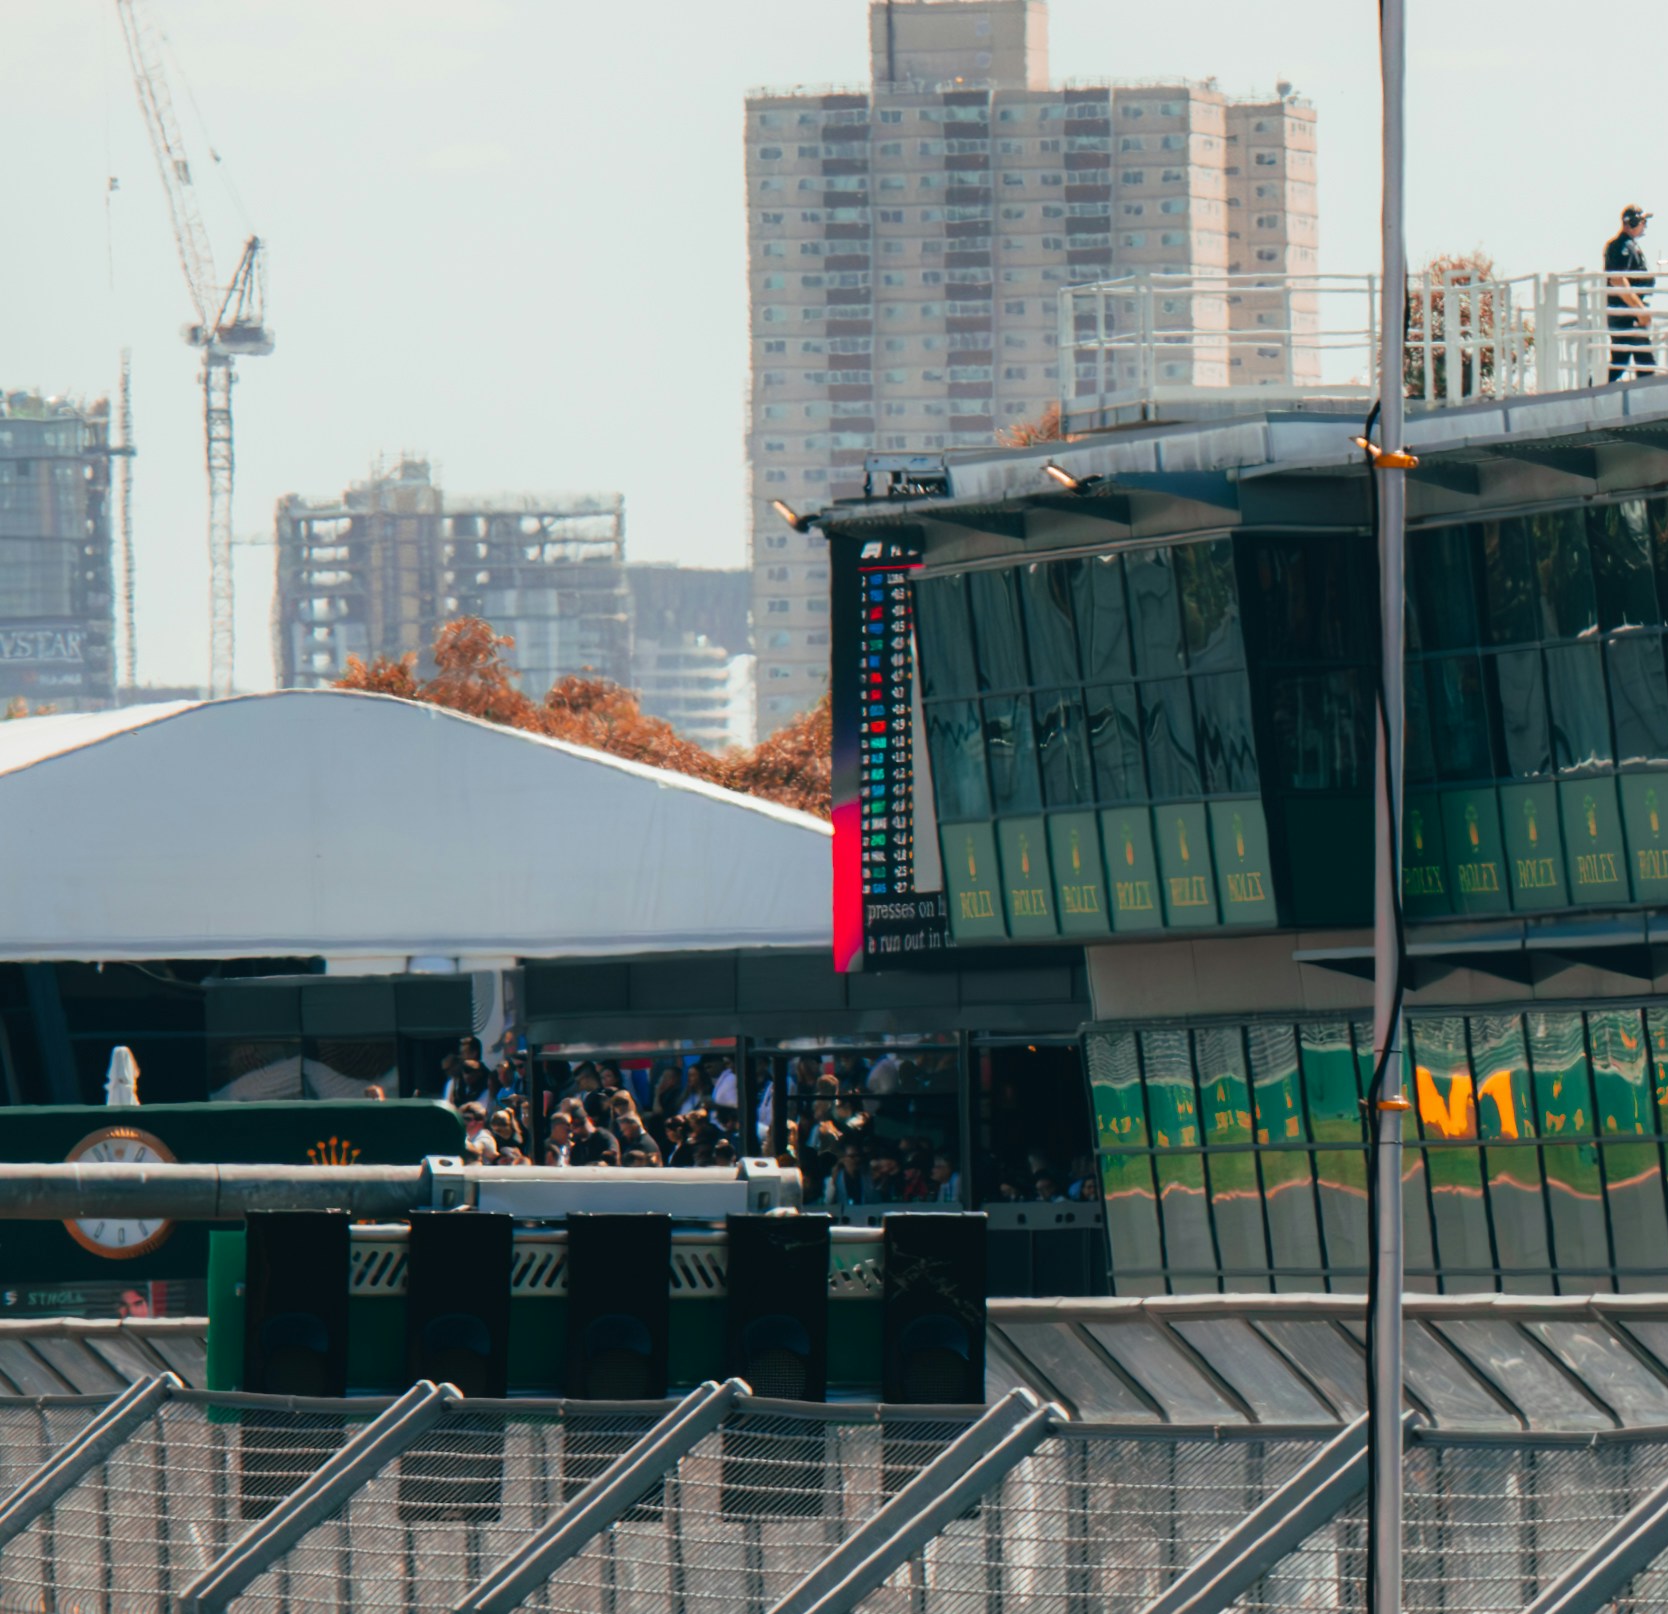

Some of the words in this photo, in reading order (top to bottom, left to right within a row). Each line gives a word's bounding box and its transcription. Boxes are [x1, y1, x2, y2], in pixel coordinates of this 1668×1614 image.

[866, 901, 916, 928] presses
[918, 901, 935, 919] on
[880, 934, 901, 953] run
[904, 930, 925, 951] out
[929, 927, 942, 948] in
